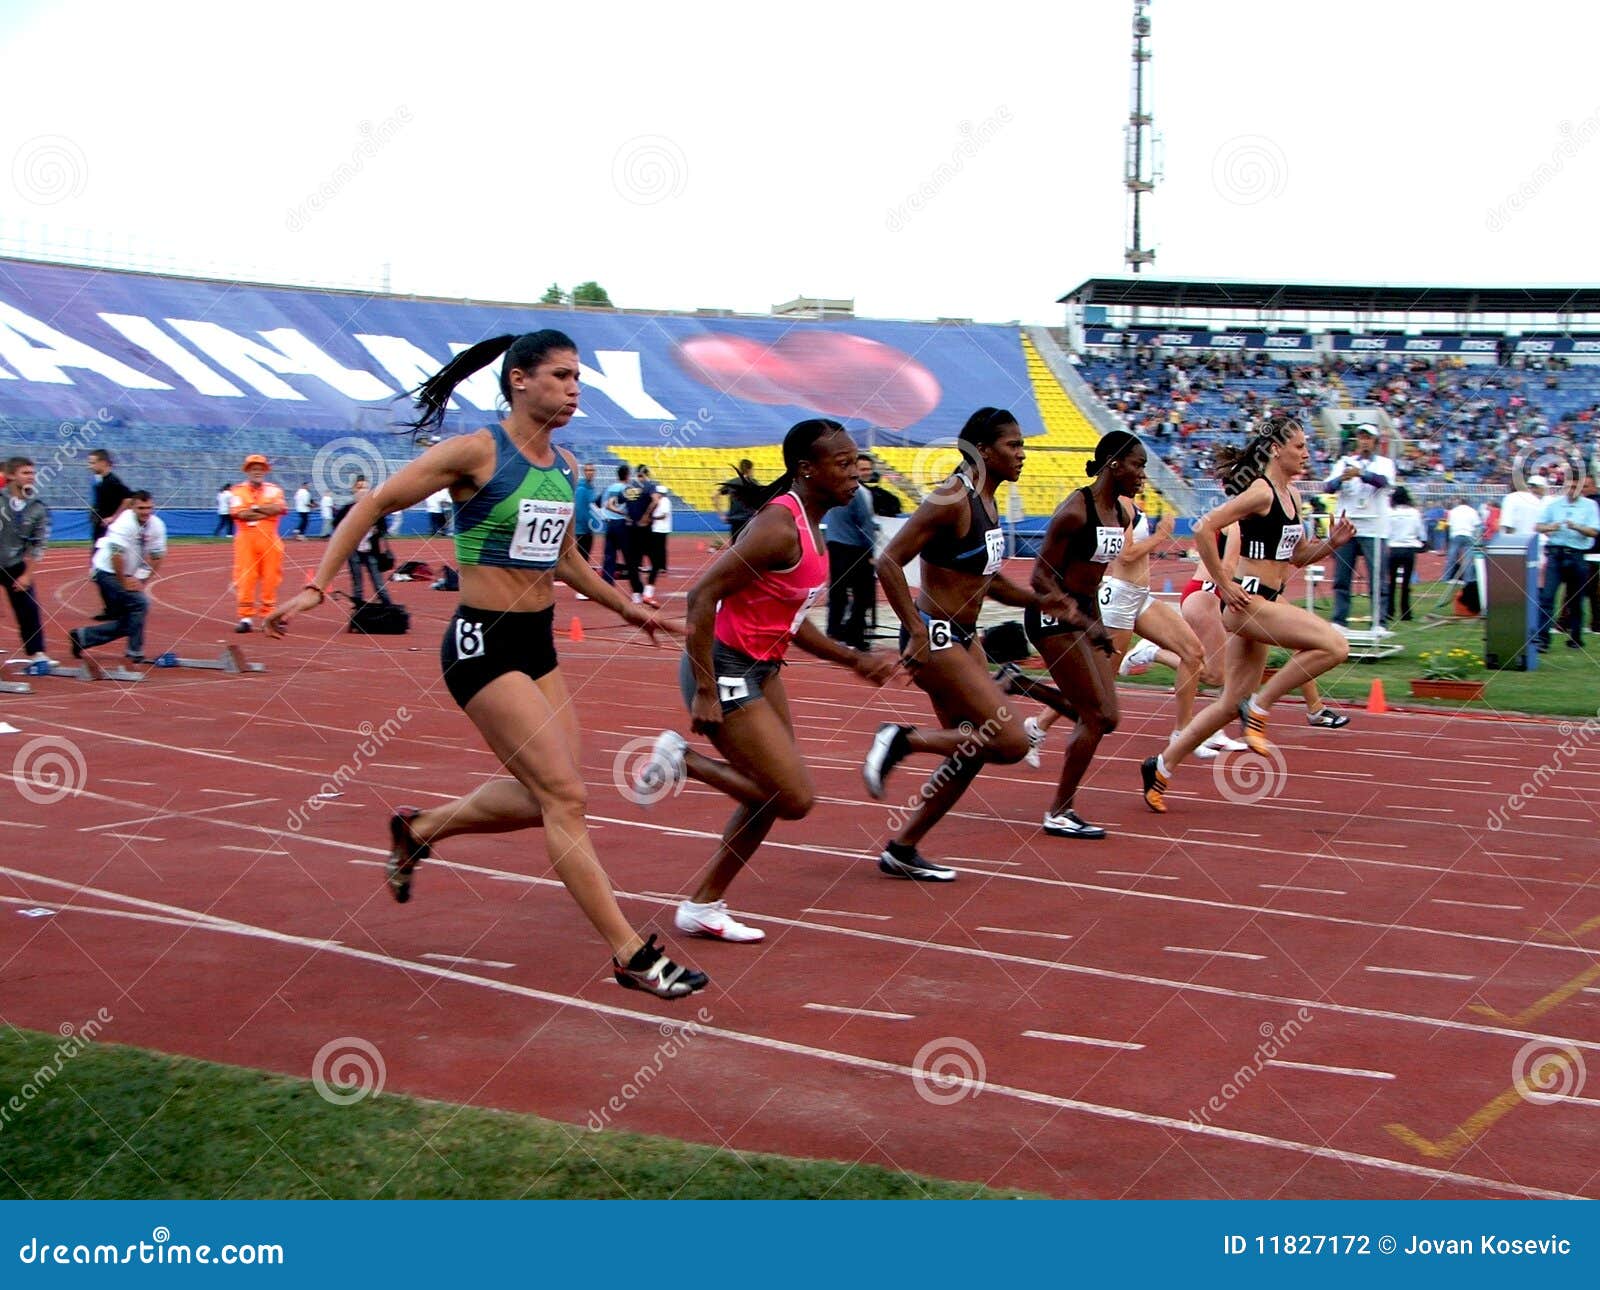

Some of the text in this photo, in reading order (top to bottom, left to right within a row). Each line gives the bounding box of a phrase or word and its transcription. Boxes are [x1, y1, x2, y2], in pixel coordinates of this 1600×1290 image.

[527, 517, 565, 545] 162
[1100, 587, 1112, 605] 3
[1244, 578, 1257, 594] 4
[460, 619, 480, 656] 8
[932, 622, 949, 647] 6
